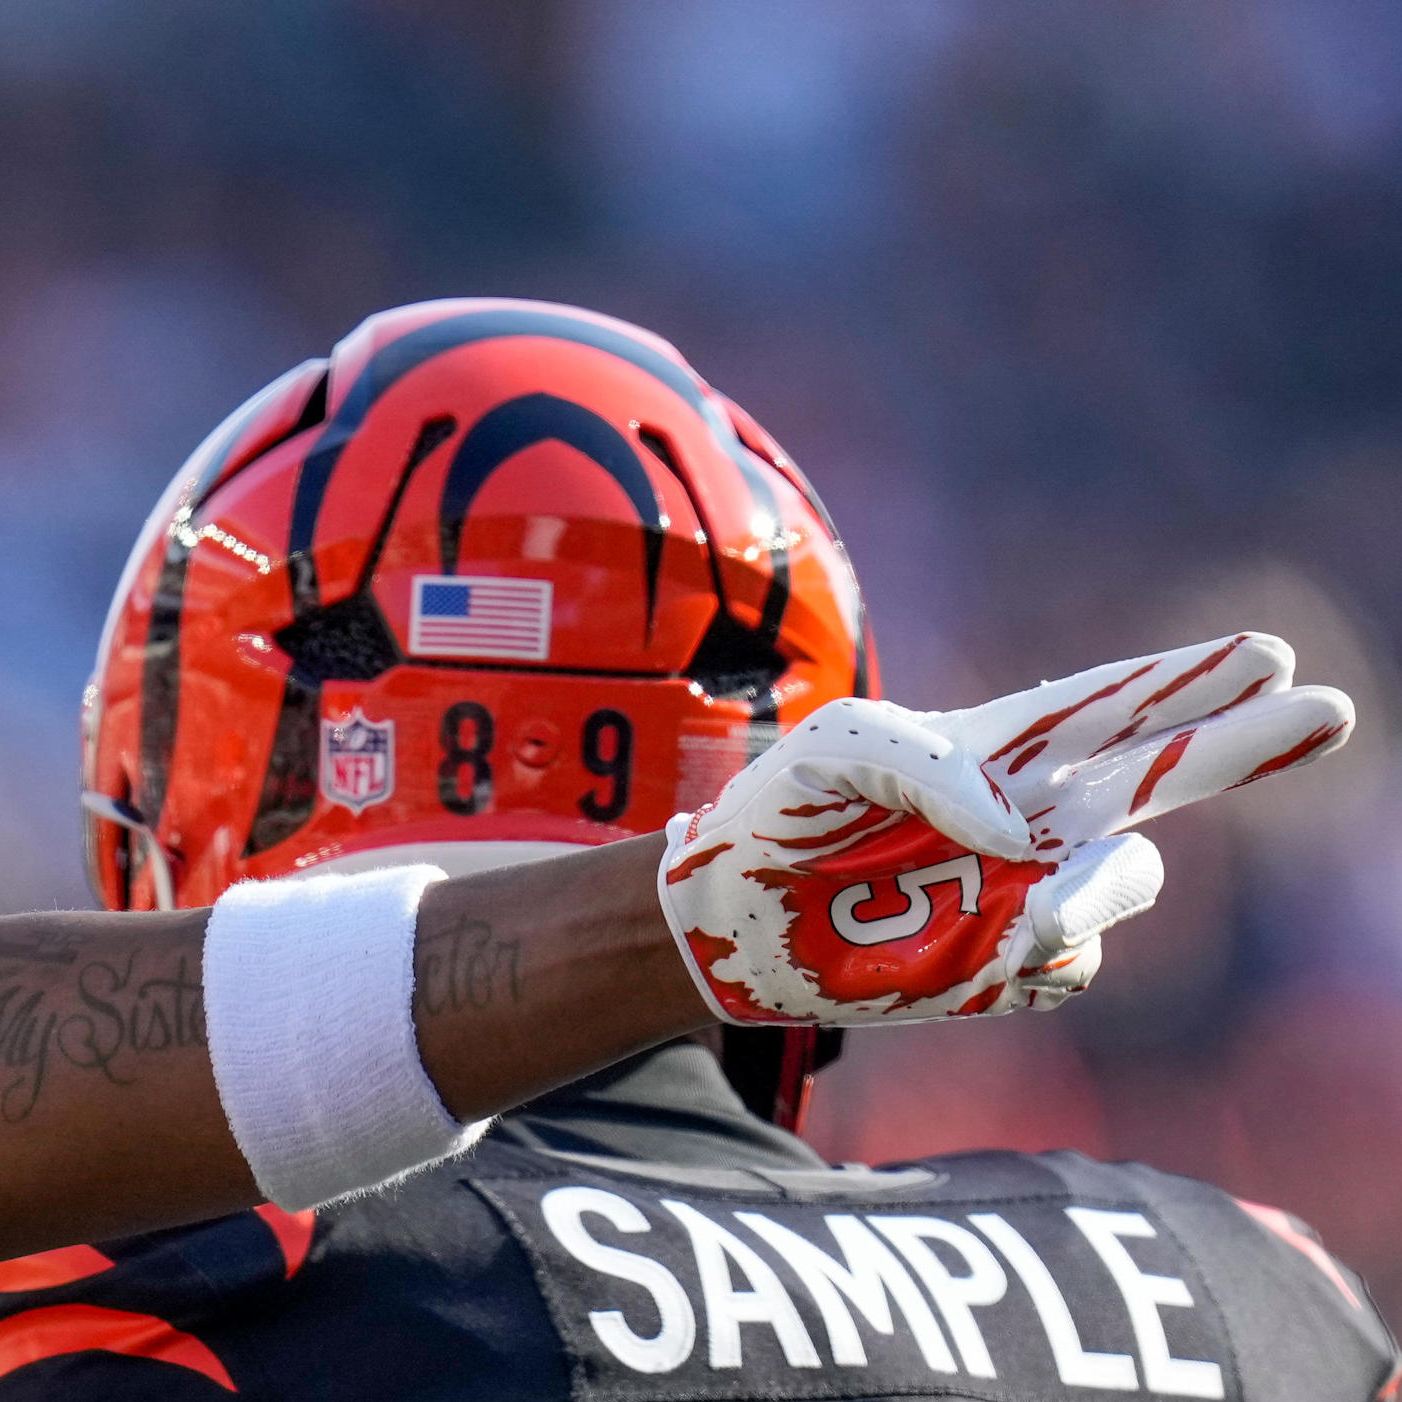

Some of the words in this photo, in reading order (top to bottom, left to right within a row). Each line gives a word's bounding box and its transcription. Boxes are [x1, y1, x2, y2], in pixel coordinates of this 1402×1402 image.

[334, 756, 384, 794] NFL
[829, 853, 983, 948] 5
[418, 913, 521, 1017] ctor
[539, 1186, 1225, 1400] SAMPLE
